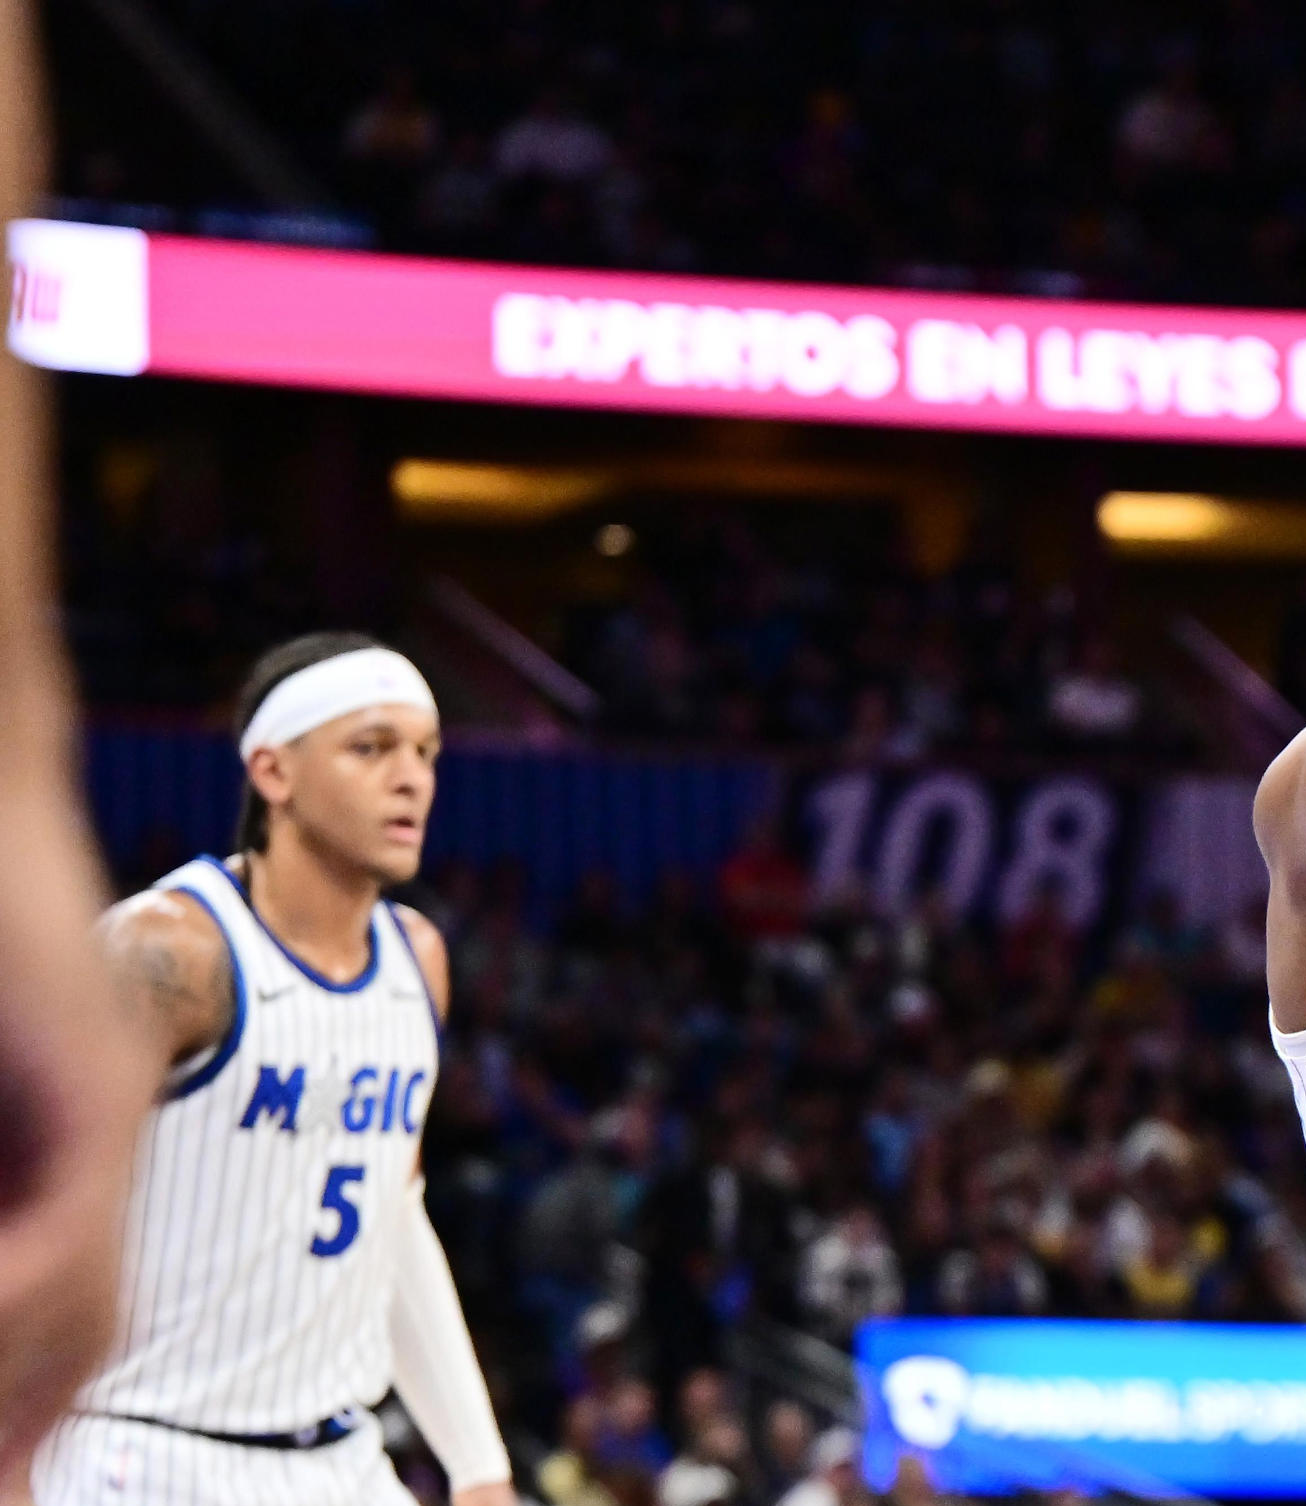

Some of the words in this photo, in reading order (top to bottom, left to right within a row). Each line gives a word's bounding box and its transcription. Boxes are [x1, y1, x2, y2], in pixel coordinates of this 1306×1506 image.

[492, 292, 897, 399] EXPERTOS
[907, 319, 1028, 404] EN
[810, 770, 1116, 928] 108
[310, 1164, 366, 1257] 5
